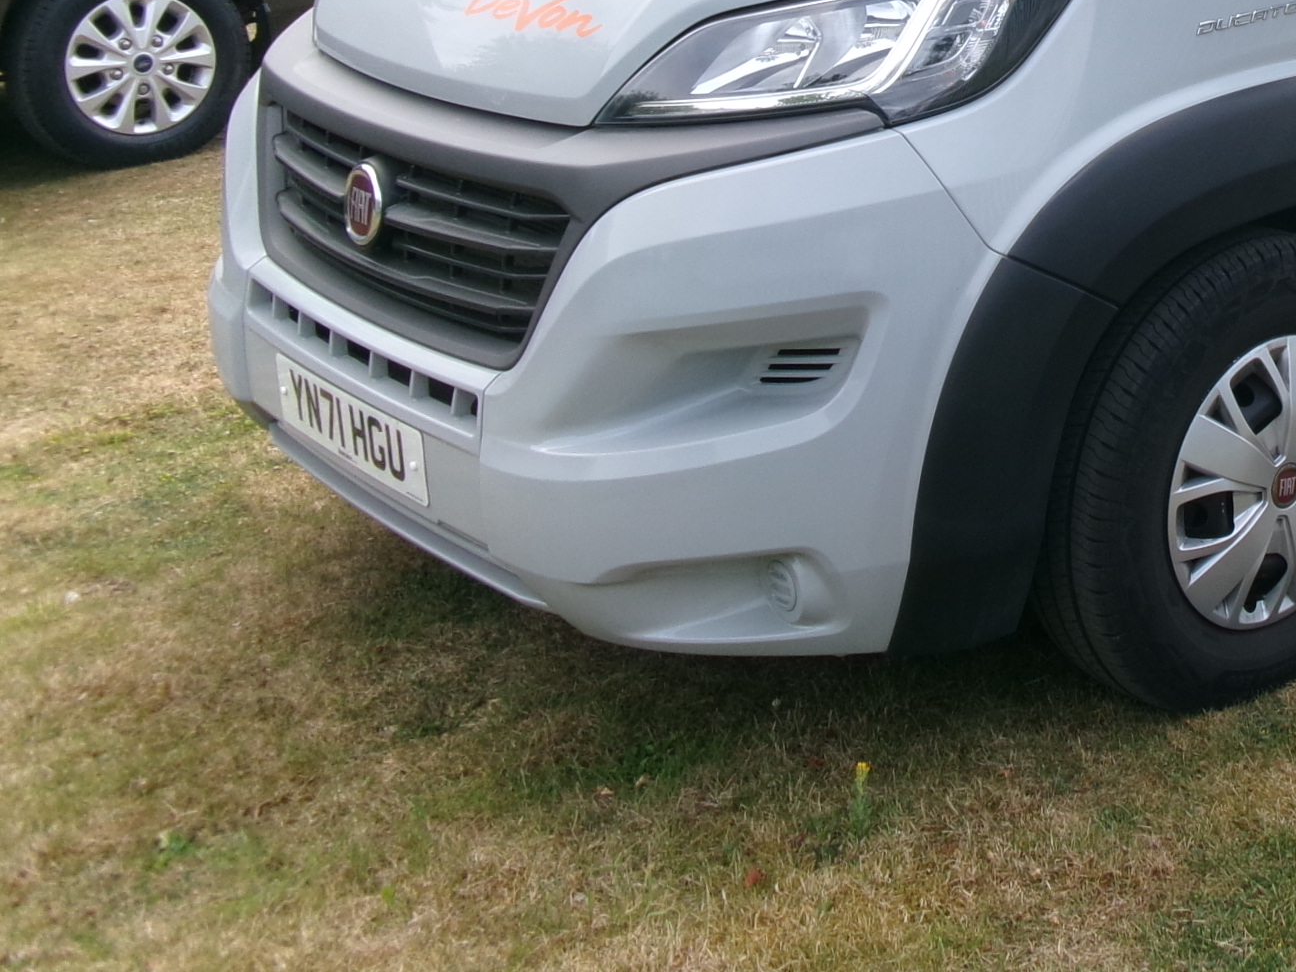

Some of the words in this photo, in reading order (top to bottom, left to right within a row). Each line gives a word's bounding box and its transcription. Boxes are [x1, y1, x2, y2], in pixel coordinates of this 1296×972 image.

[350, 186, 372, 226] FIAT
[289, 369, 346, 449] YN71
[348, 403, 406, 482] HGU
[1279, 476, 1296, 497] FIAT
